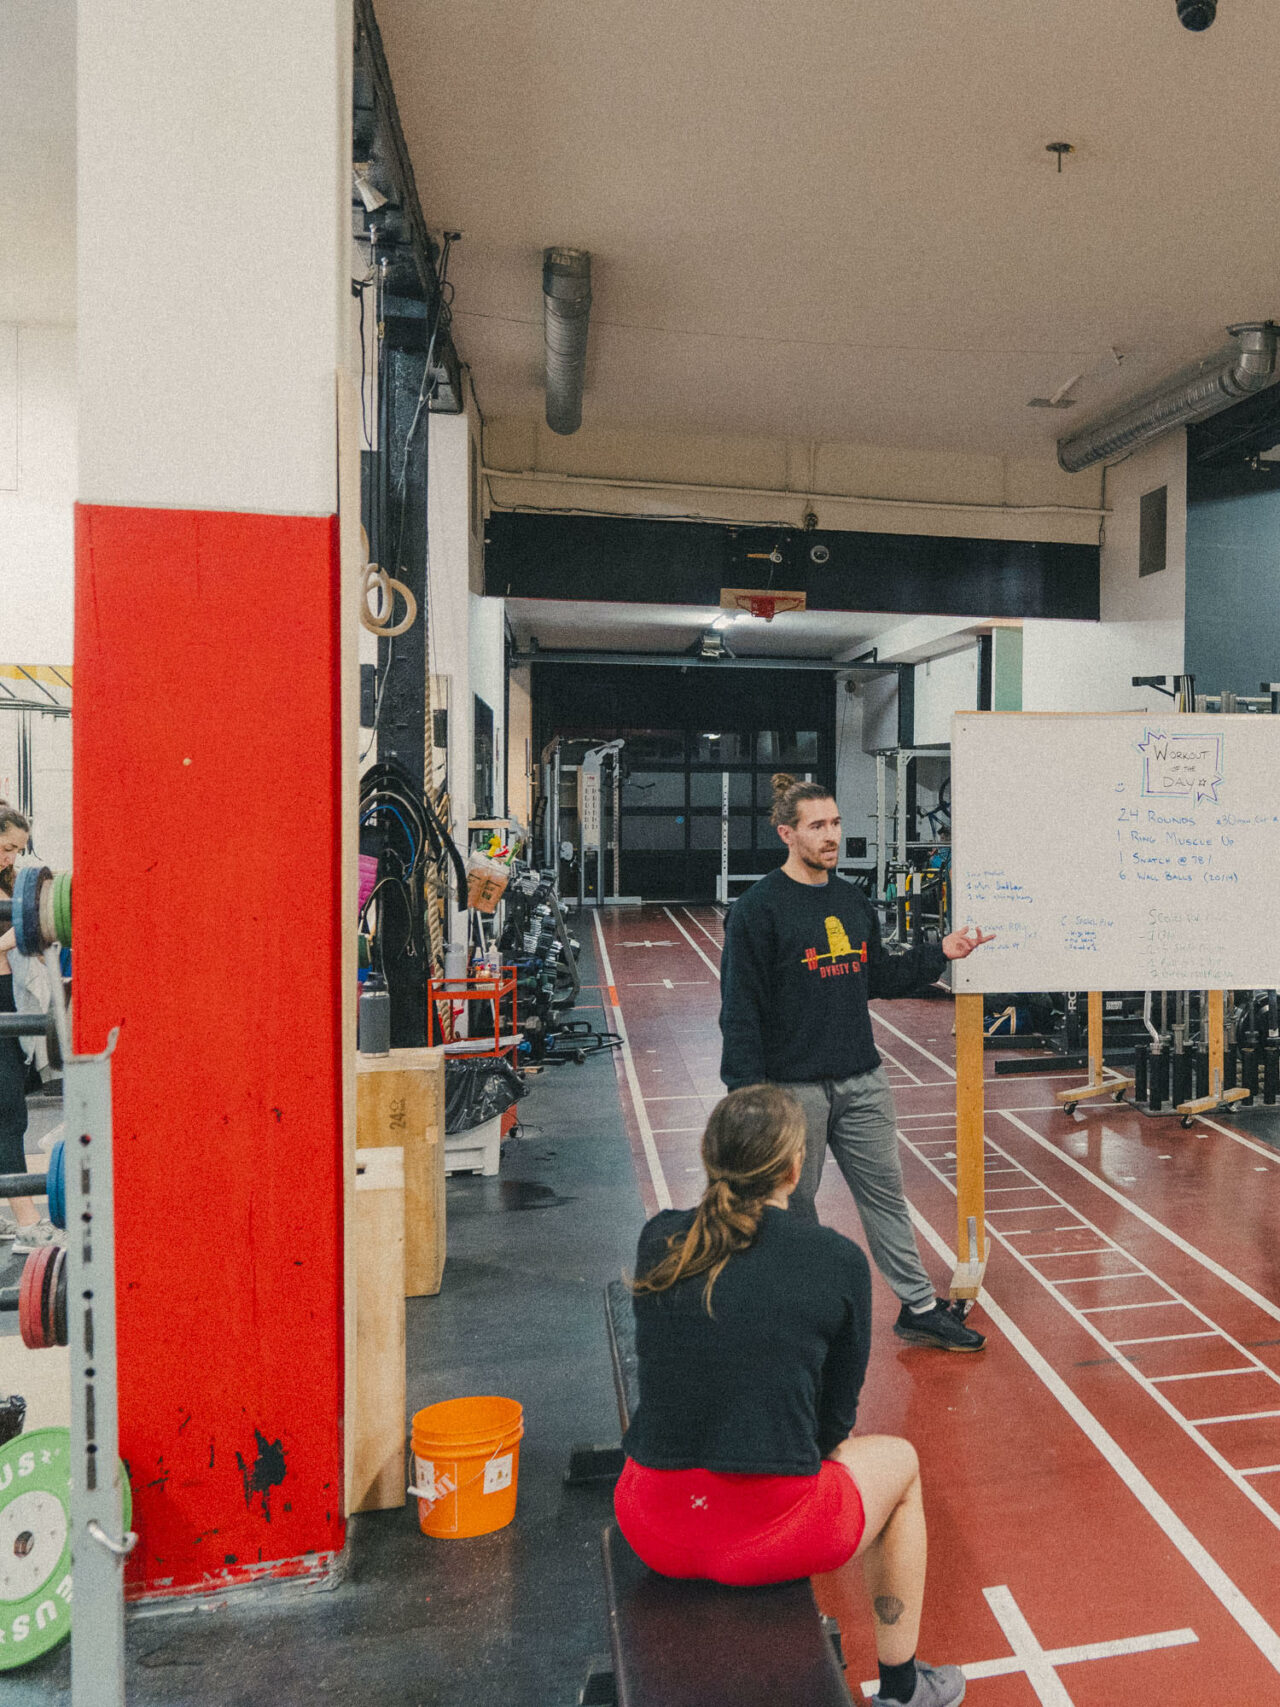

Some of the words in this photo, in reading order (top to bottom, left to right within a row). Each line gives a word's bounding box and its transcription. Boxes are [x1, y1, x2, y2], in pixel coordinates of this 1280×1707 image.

[1163, 776, 1196, 791] DAY
[1118, 808, 1138, 822] 24
[1119, 869, 1126, 881] 6
